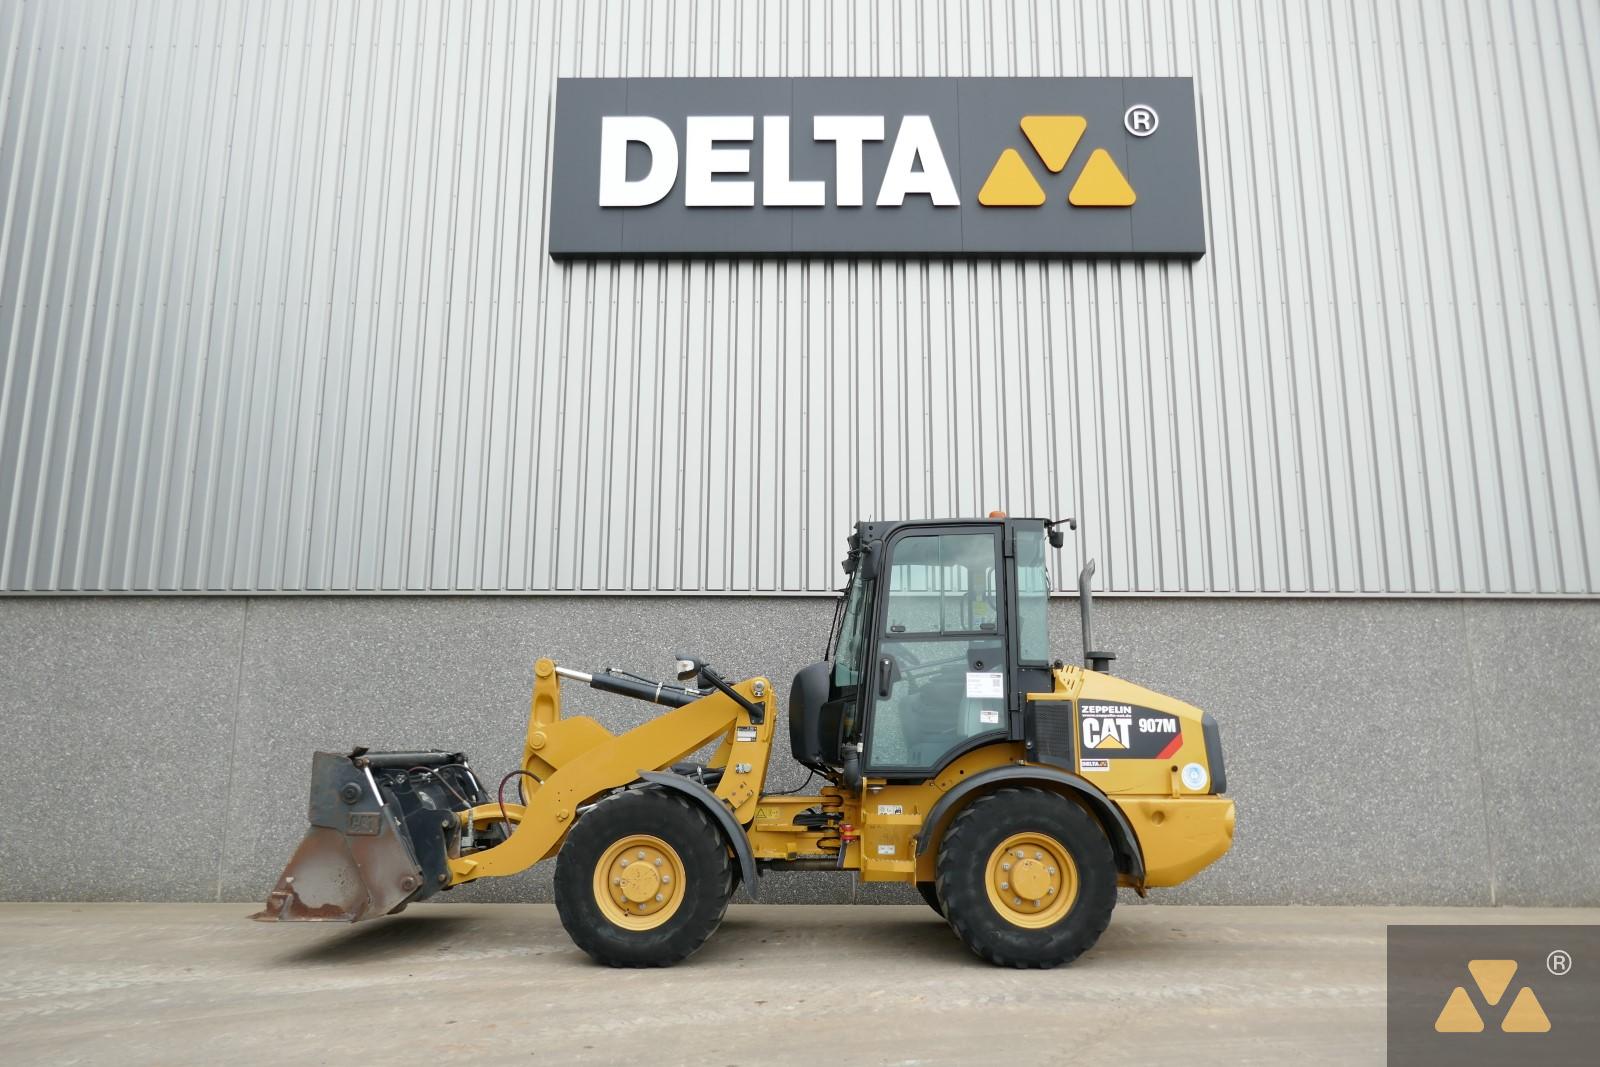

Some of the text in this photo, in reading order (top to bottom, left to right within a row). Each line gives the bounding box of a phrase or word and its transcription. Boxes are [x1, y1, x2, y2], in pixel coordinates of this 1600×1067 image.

[599, 115, 961, 207] DELTA
[1081, 705, 1132, 714] ZEPPELIN
[1082, 717, 1133, 749] CAT
[1138, 718, 1176, 733] 907M
